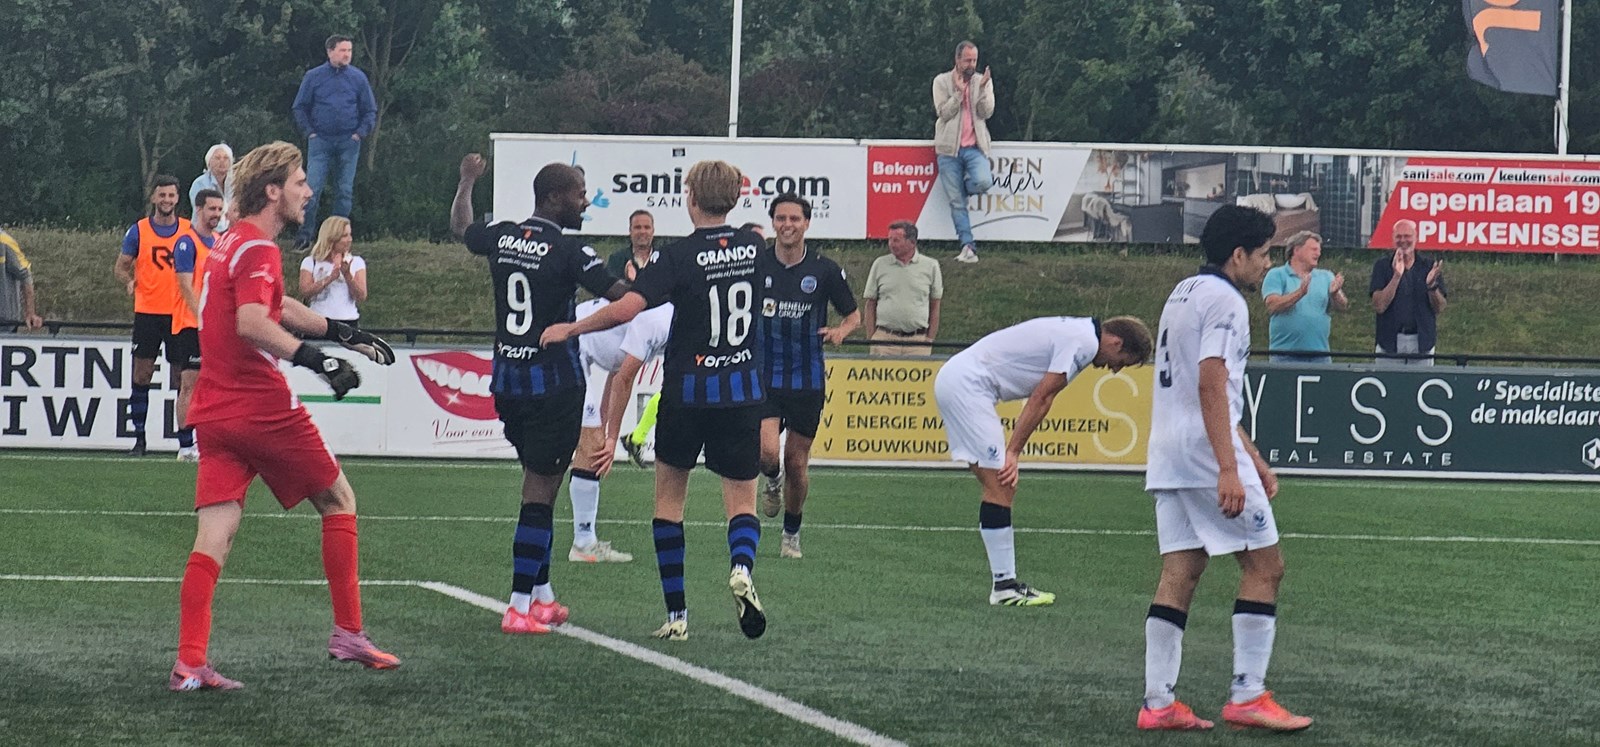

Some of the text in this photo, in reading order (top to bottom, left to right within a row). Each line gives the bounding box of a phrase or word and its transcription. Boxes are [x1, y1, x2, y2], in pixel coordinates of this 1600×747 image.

[872, 161, 934, 176] Bekend
[1403, 168, 1600, 184] sanisale.com keukensale.com
[872, 180, 930, 194] van TV
[1400, 186, 1600, 216] Iepenlaan 19
[1417, 220, 1600, 247] PIJKENISSE
[497, 234, 549, 257] GRANDO
[696, 244, 757, 267] GRANDO
[506, 271, 533, 336] 9
[708, 281, 753, 348] 18
[846, 367, 933, 382] AANKOOP
[846, 391, 926, 407] TAXATIES
[1244, 374, 1453, 446] YESS
[1470, 402, 1600, 426] de makelaar
[846, 414, 918, 429] ENERGIE
[846, 438, 950, 454] BOUWKUND
[1344, 450, 1452, 466] ESTATE
